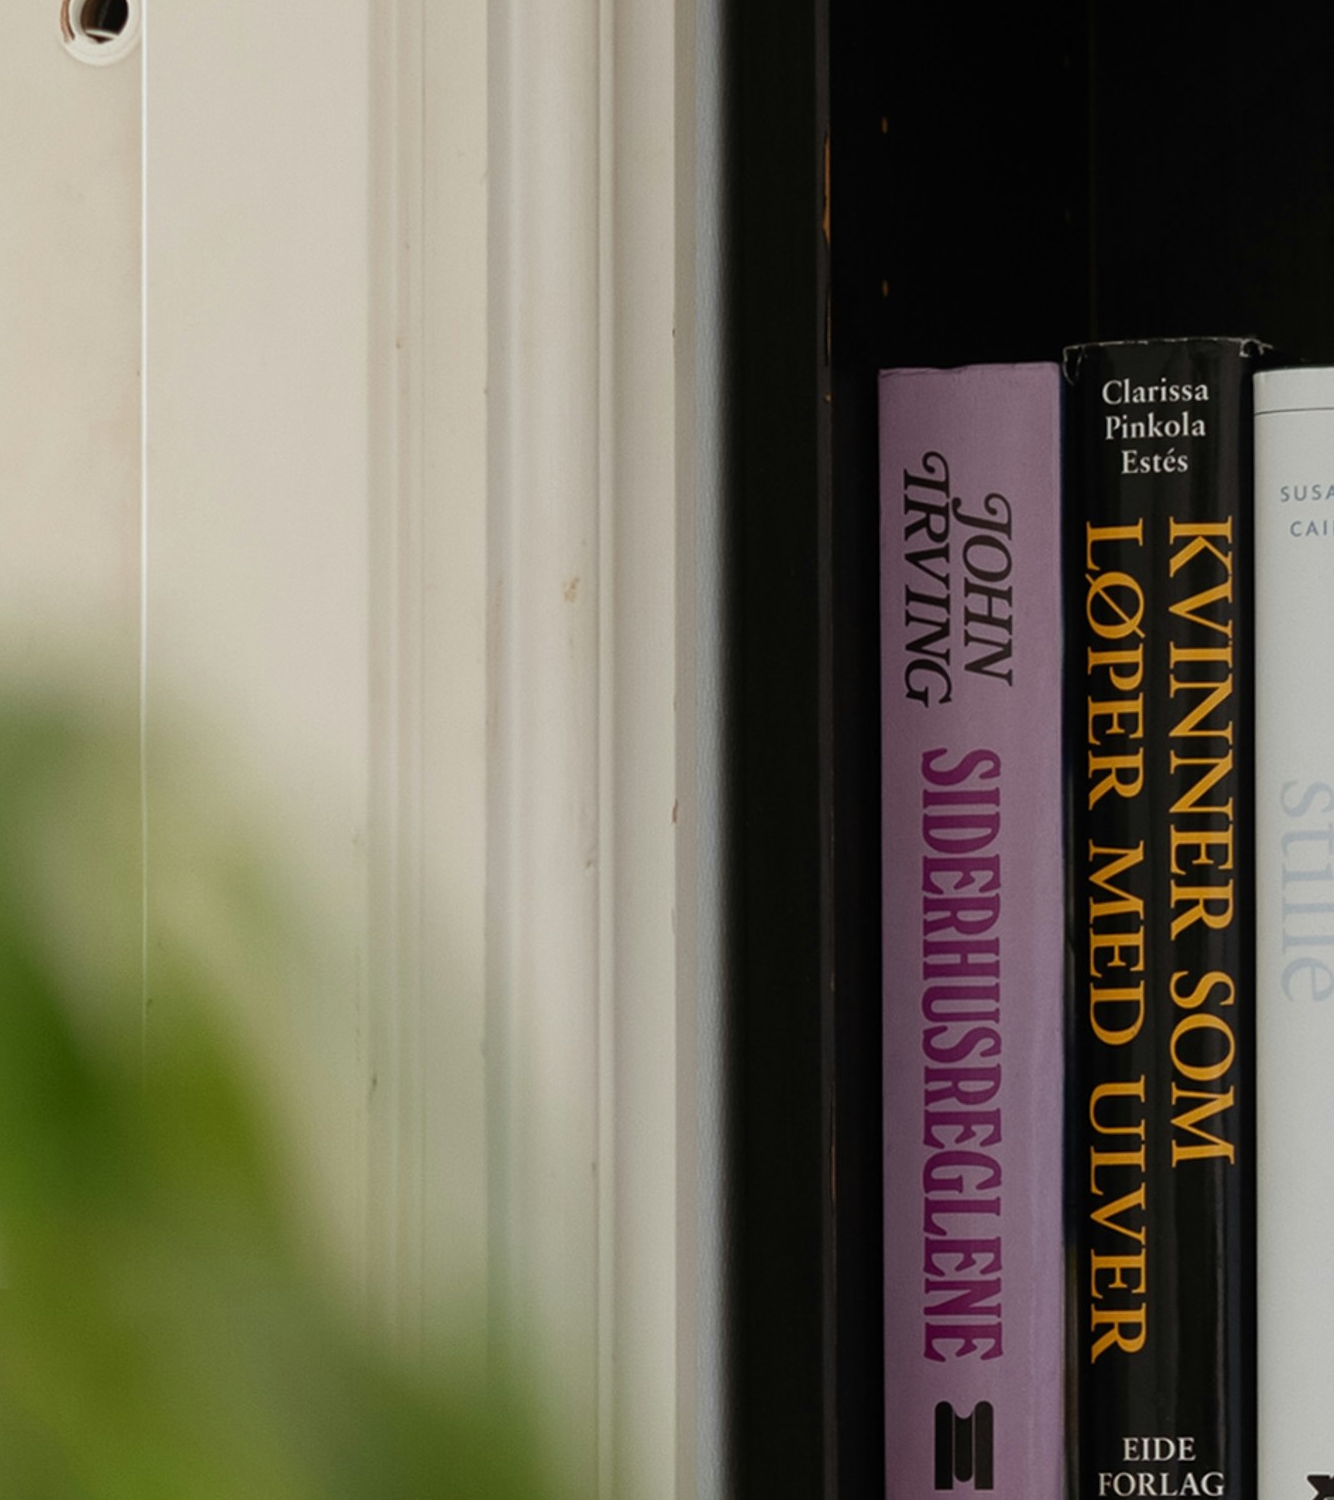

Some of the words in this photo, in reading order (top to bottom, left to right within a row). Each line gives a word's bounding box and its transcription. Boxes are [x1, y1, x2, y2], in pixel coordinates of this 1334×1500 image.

[1100, 377, 1208, 406] Clarissa
[1104, 412, 1207, 441] Pinkola
[1120, 449, 1189, 476] Estés
[903, 451, 953, 709] IRVING
[952, 492, 1014, 687] JOHN
[1084, 518, 1146, 811] LØPER
[1169, 516, 1235, 941] KVINNER
[1086, 839, 1146, 1047] MED
[920, 746, 1003, 1362] SIDERHUSREGLENE
[1169, 970, 1236, 1168] SOM
[1088, 1075, 1147, 1365] ULVER
[1096, 1470, 1226, 1497] FORLAG
[1122, 1436, 1197, 1462] EIDE
